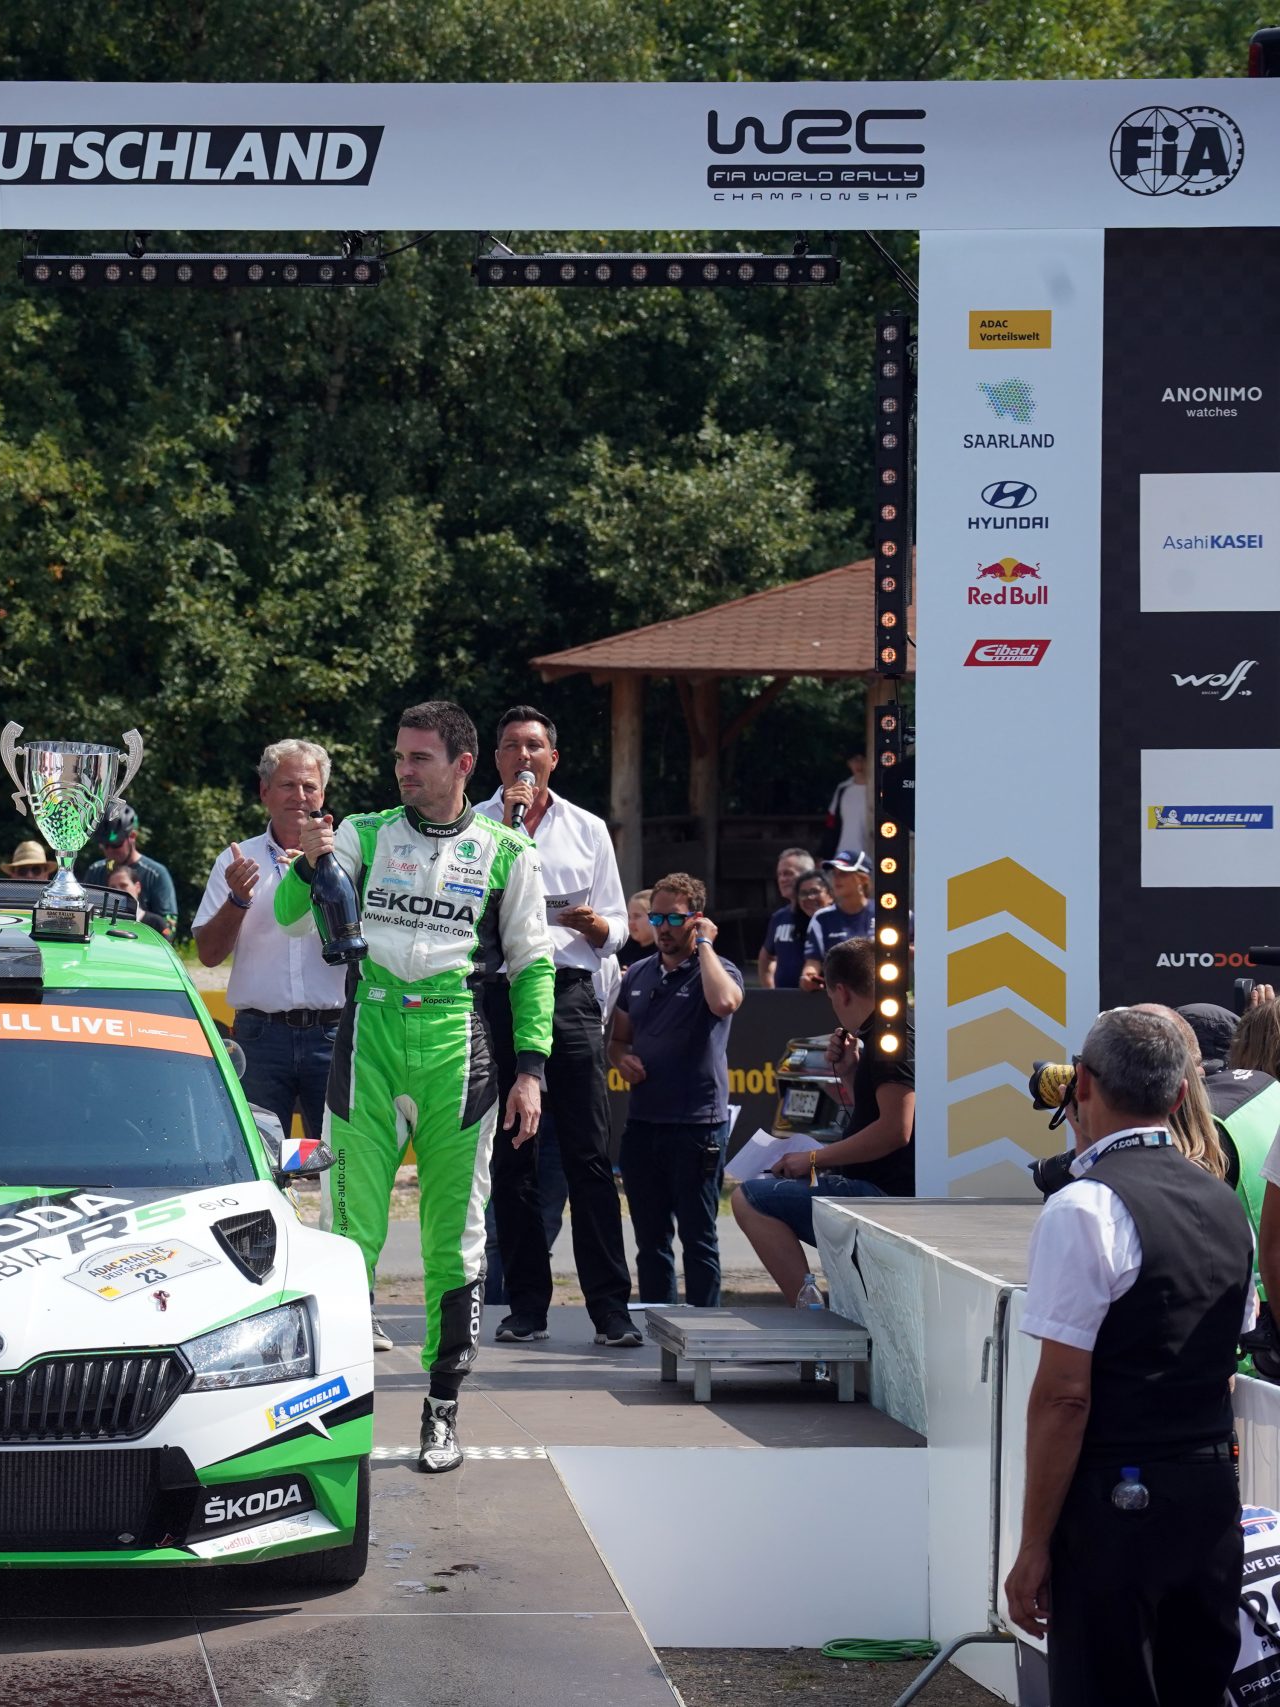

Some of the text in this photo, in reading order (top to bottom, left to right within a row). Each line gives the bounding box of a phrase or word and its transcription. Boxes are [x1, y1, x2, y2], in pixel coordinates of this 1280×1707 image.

[707, 109, 926, 154] WRC
[713, 171, 919, 182] FIA WORLD RALLY
[713, 192, 918, 201] CHAMPIONSHIP
[979, 319, 1009, 328] ADAC
[979, 332, 1040, 341] Vorteilswelt
[1161, 386, 1263, 402] ANONIMO
[1186, 407, 1238, 417] watches
[963, 433, 1055, 449] SAARLAND
[968, 516, 1049, 529] HYUNDAI
[968, 586, 1048, 605] Red Bull
[974, 643, 1040, 662] Eibach
[1183, 813, 1263, 823] MICHELIN
[366, 888, 474, 925] ŠKODA
[364, 911, 473, 939] www.skoda-auto.com
[51, 1015, 125, 1037] LIVE
[66, 1198, 187, 1255] R5
[197, 1196, 240, 1212] evo
[87, 1259, 121, 1278] ADAC
[119, 1246, 170, 1266] RALLYE
[101, 1254, 168, 1281] DEUTSCHLAND
[134, 1268, 168, 1284] 23
[289, 1385, 341, 1416] MICHELIN
[204, 1483, 303, 1524] ŠKODA
